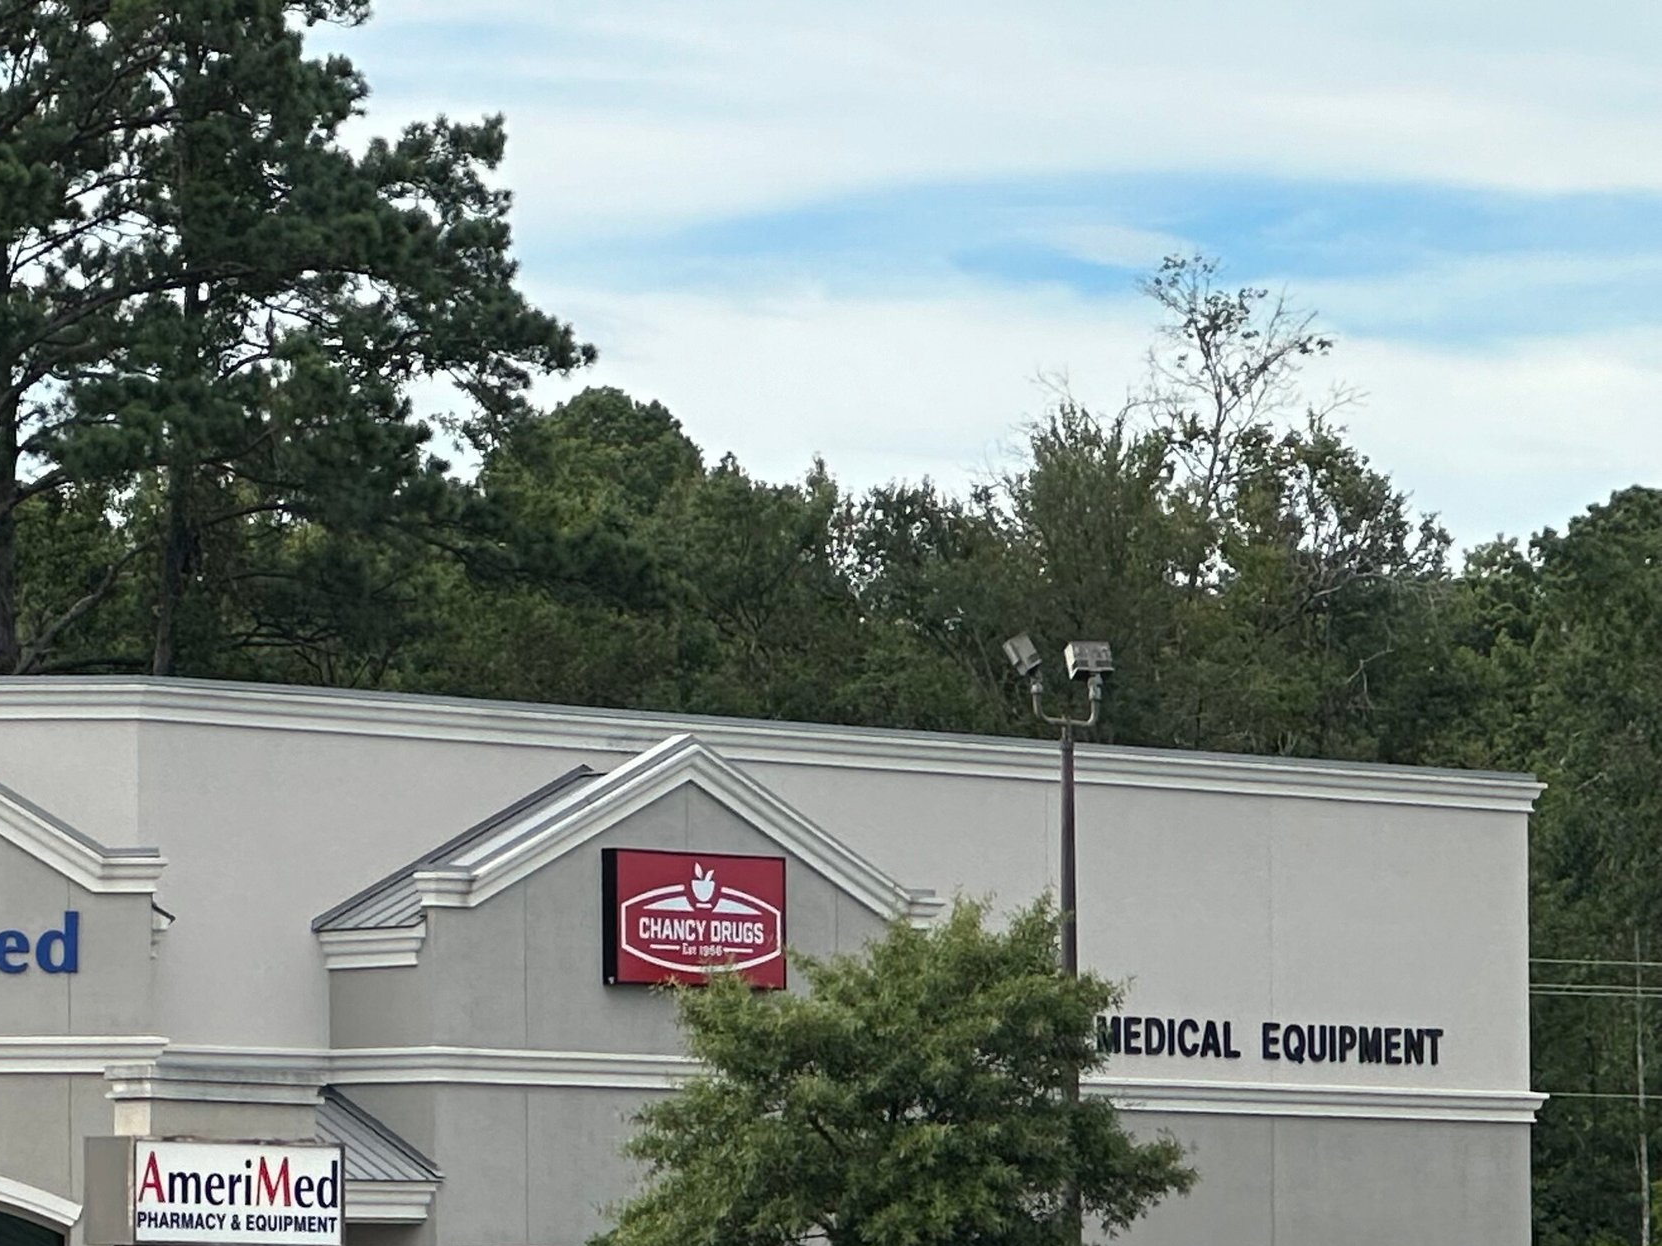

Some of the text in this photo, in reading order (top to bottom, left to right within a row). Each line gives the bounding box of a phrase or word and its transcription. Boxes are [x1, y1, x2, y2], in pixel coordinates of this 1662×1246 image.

[638, 916, 765, 945] CHANCY DRUGS
[681, 942, 698, 956] Est
[1096, 1014, 1444, 1066] MEDICAL EQUIPMENT
[138, 1150, 339, 1209] AmeriMed
[137, 1211, 338, 1234] PHARMACY & EQUIPMENT
